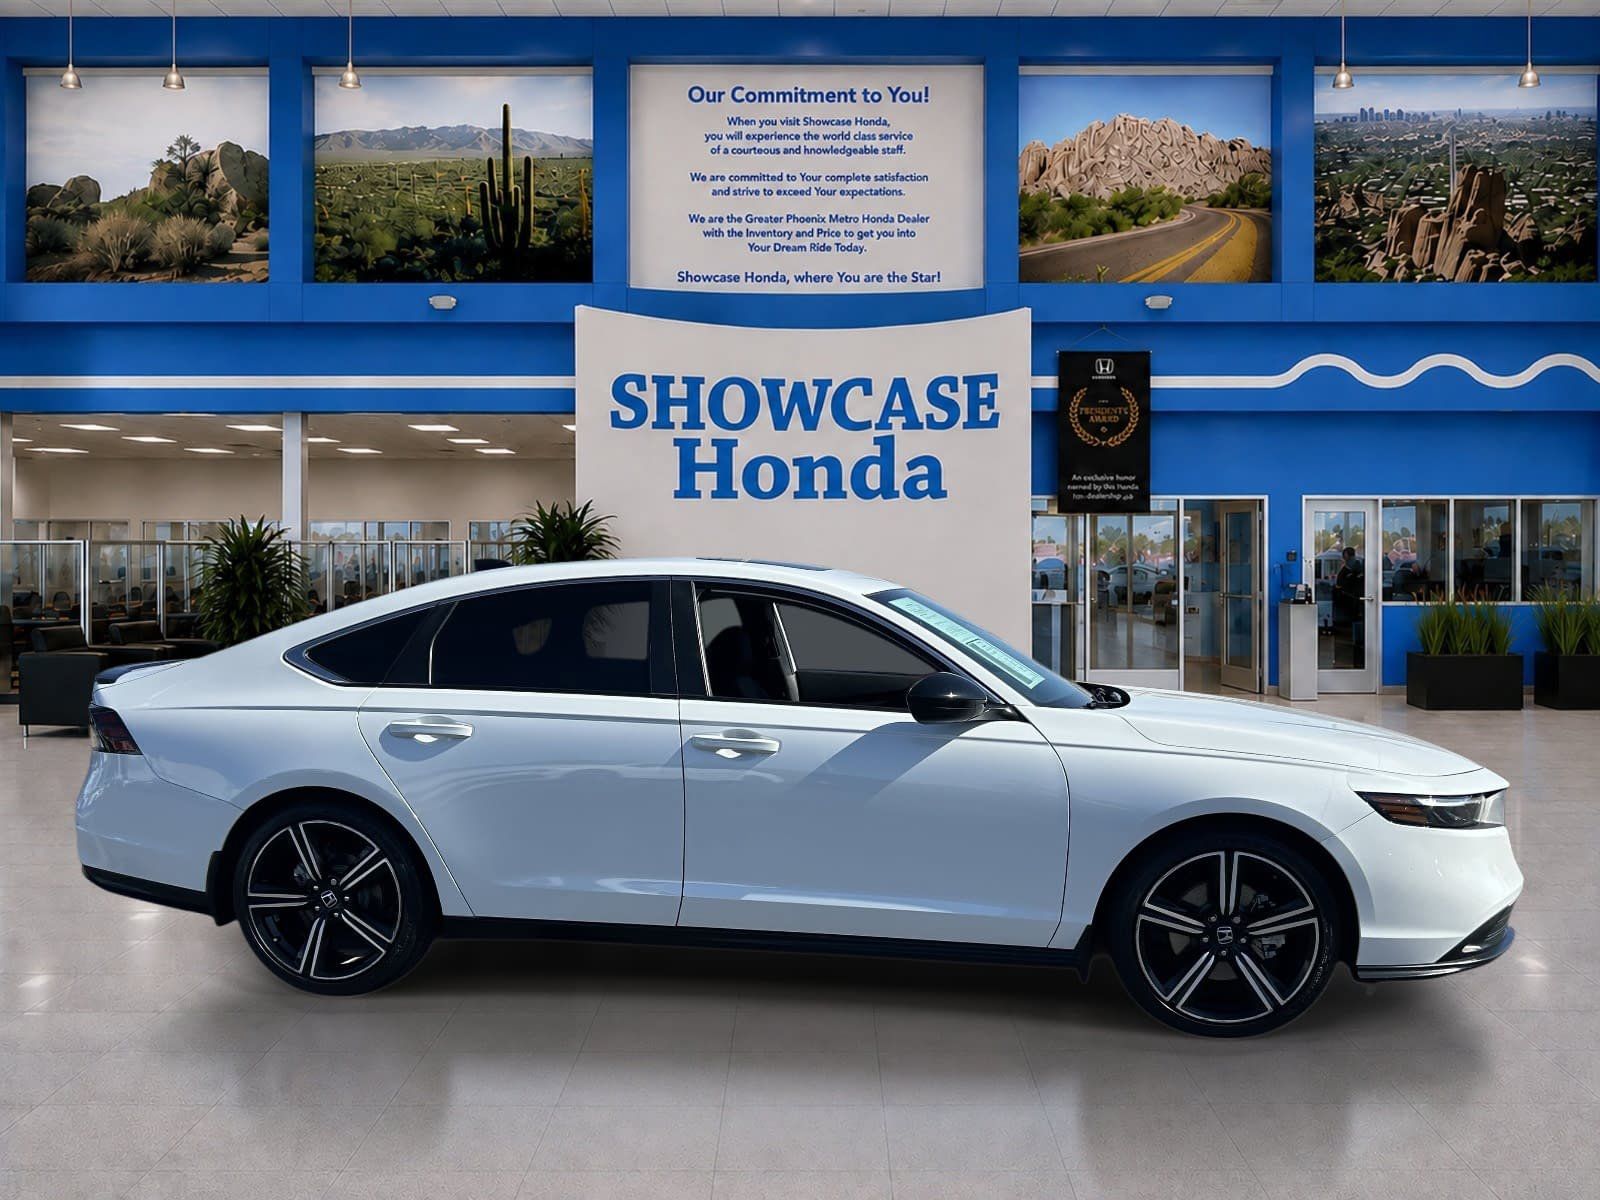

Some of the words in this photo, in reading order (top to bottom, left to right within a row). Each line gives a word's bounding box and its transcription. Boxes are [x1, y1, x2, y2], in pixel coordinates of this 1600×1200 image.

[687, 85, 726, 104] Our
[730, 85, 857, 104] Commitment
[861, 87, 883, 104] to
[886, 85, 929, 104] You!
[726, 116, 757, 127] When
[758, 118, 778, 129] you
[779, 116, 801, 127] visit
[802, 116, 853, 127] Showcase
[854, 116, 891, 128] Honda,
[704, 133, 724, 144] you
[725, 130, 743, 141] will
[745, 130, 801, 144] experience
[802, 130, 820, 141] the
[822, 130, 851, 141] world
[853, 130, 877, 141] class
[878, 130, 914, 141] service
[710, 144, 721, 155] of
[722, 146, 730, 155] a
[730, 146, 781, 155] courteous
[782, 144, 802, 155] and
[689, 172, 707, 183] We
[709, 174, 726, 182] are
[728, 171, 784, 183] committed
[785, 173, 798, 182] to
[799, 172, 823, 183] Your
[824, 172, 872, 185] complete
[873, 171, 929, 183] satisfaction
[711, 186, 731, 197] and
[732, 186, 761, 197] strive
[762, 187, 774, 197] to
[775, 186, 812, 197] exceed
[814, 186, 838, 197] Your
[839, 186, 906, 200] expectations.
[688, 213, 706, 224] We
[707, 215, 725, 224] are
[726, 213, 743, 224] the
[744, 213, 784, 224] Greater
[786, 213, 827, 224] Phoenix
[828, 213, 860, 224] Metro
[861, 213, 895, 224] Honda
[897, 213, 930, 224] Dealer
[702, 227, 725, 238] with
[726, 227, 744, 238] the
[745, 227, 794, 241] Inventory
[795, 227, 815, 238] and
[816, 227, 842, 238] Price
[843, 229, 855, 238] to
[856, 229, 875, 241] get
[876, 230, 895, 241] you
[896, 228, 917, 238] into
[747, 242, 772, 253] Your
[773, 242, 807, 253] Dream
[809, 242, 832, 253] Ride
[833, 242, 867, 255] Today.
[677, 270, 741, 284] Showcase
[744, 270, 790, 285] Honda,
[793, 271, 834, 284] where
[836, 271, 861, 284] You
[863, 274, 884, 284] are
[886, 270, 908, 284] the
[911, 271, 941, 284] Star!
[610, 373, 1000, 432] SHOWCASE
[672, 434, 948, 501] Honda
